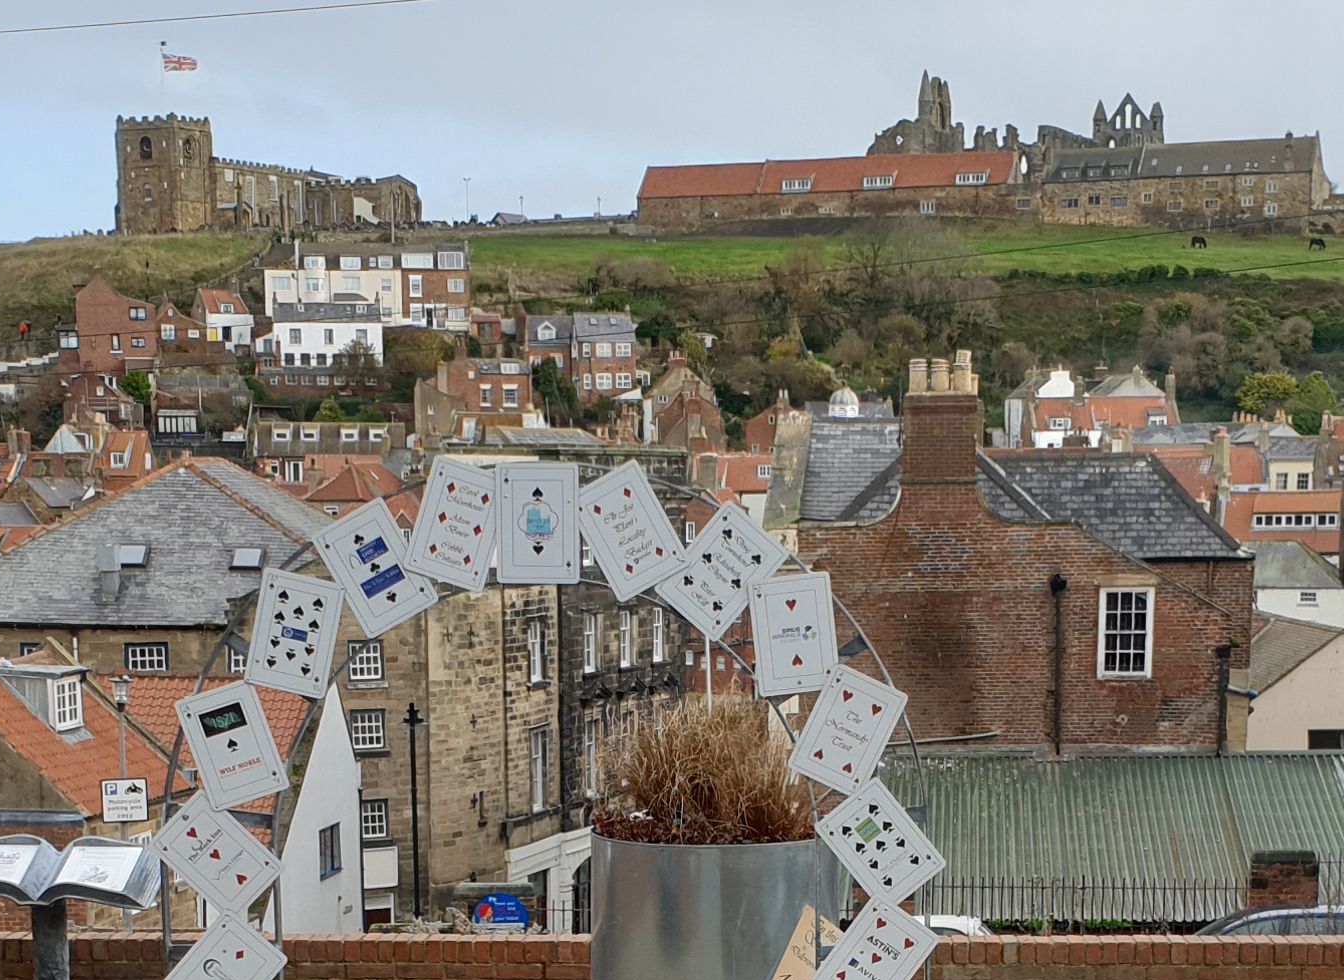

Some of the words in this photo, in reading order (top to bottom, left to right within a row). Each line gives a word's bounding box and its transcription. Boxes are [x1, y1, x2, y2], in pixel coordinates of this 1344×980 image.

[846, 710, 863, 725] The
[831, 735, 853, 752] Trust
[866, 935, 899, 961] ASTIN'S
